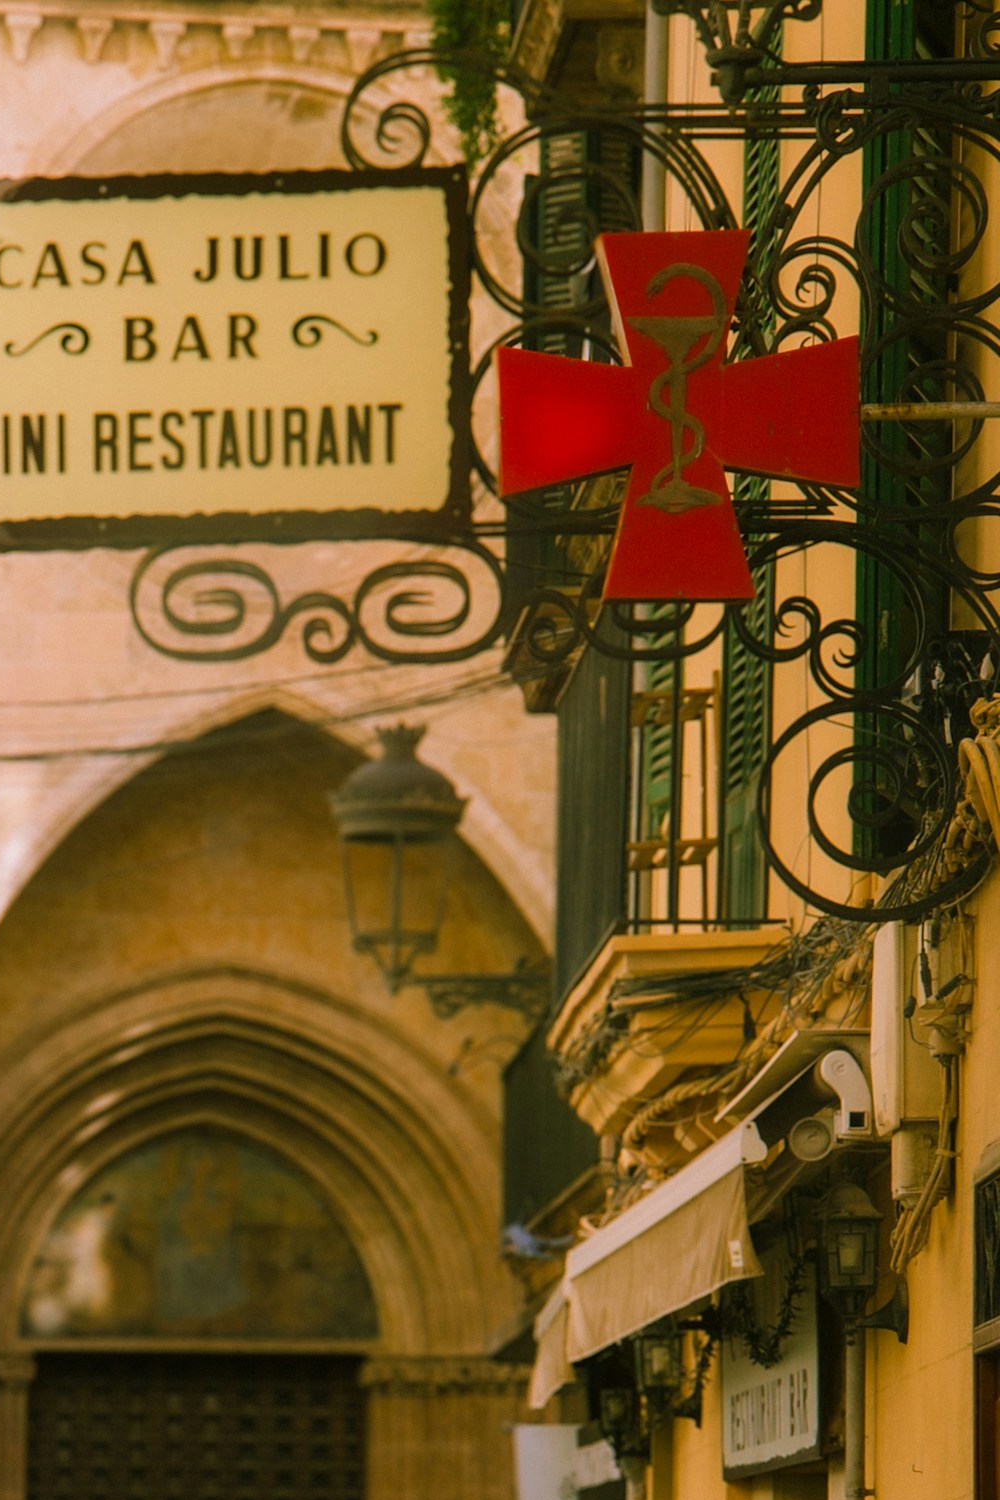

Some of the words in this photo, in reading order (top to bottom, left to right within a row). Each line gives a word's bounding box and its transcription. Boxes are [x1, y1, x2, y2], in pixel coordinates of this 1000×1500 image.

[193, 231, 388, 283] JULIO
[123, 313, 259, 363] BAR
[92, 402, 404, 473] RESTAURANT
[788, 1368, 809, 1437] BAR
